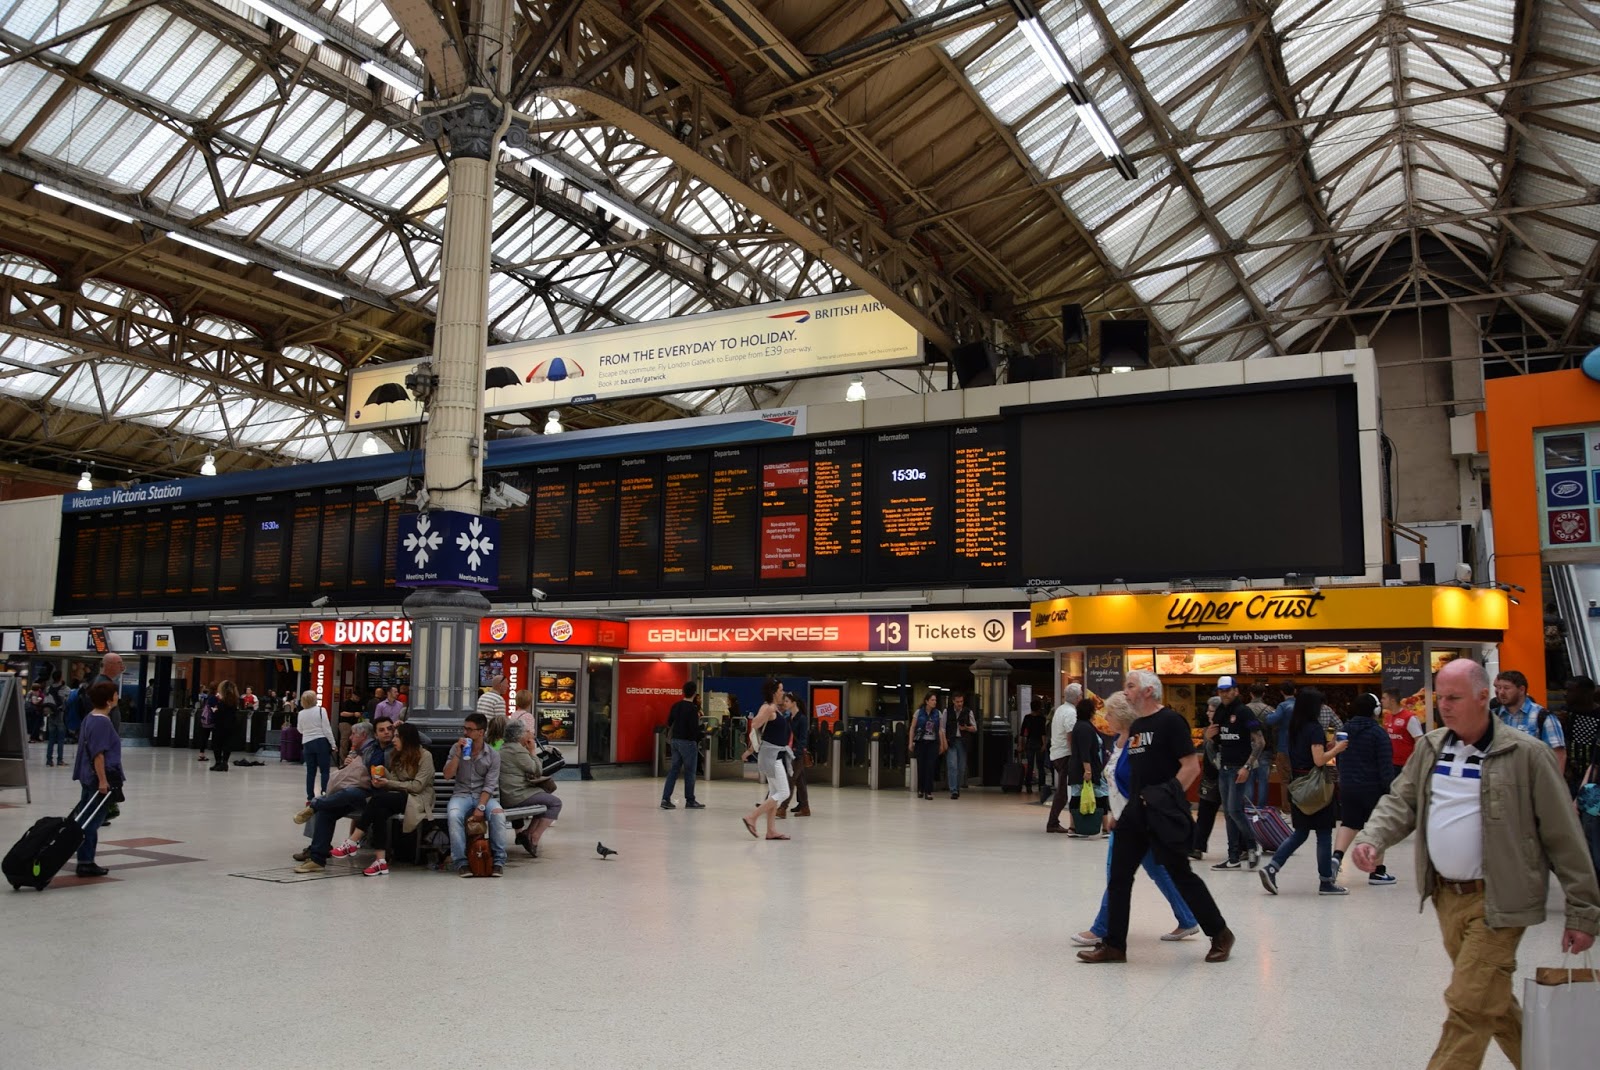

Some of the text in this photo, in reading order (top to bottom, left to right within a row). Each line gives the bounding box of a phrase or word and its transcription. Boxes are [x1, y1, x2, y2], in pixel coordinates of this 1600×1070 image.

[815, 304, 858, 320] BRITISH
[599, 329, 797, 367] FROM THE EVERYDAY TO HOLIDAY.
[668, 360, 690, 370] London
[691, 356, 715, 366] Gatwick
[724, 353, 747, 363] Europe
[764, 345, 782, 357] £39
[620, 373, 666, 385] ba.com/gatwick
[878, 432, 910, 442] Information
[956, 427, 978, 435] Arrivals
[815, 439, 846, 448] Next fastest
[667, 454, 692, 462] Departures
[714, 449, 740, 458] Departures
[621, 458, 646, 467] Departures
[798, 478, 809, 486] Plat
[72, 484, 183, 508] Welcome to Victoria Station
[1557, 512, 1581, 523] COSTA
[1556, 528, 1586, 541] COFFEE
[405, 572, 437, 581] Meeting Point
[458, 572, 489, 584] Meeting Point
[1026, 578, 1062, 586] JCDecaux
[1166, 591, 1326, 629] Upper Crust
[278, 631, 290, 645] 12
[334, 620, 413, 643] BURGER
[552, 628, 571, 638] KING
[875, 621, 902, 645] 13
[915, 624, 977, 639] Tickets
[1020, 620, 1032, 643] 1
[1198, 633, 1231, 642] famously
[1253, 632, 1294, 641] baguettes
[135, 633, 143, 647] 11
[1088, 652, 1121, 668] HOT
[1383, 648, 1422, 665] HOT
[316, 664, 325, 707] BURGER
[508, 666, 518, 714] BURGER
